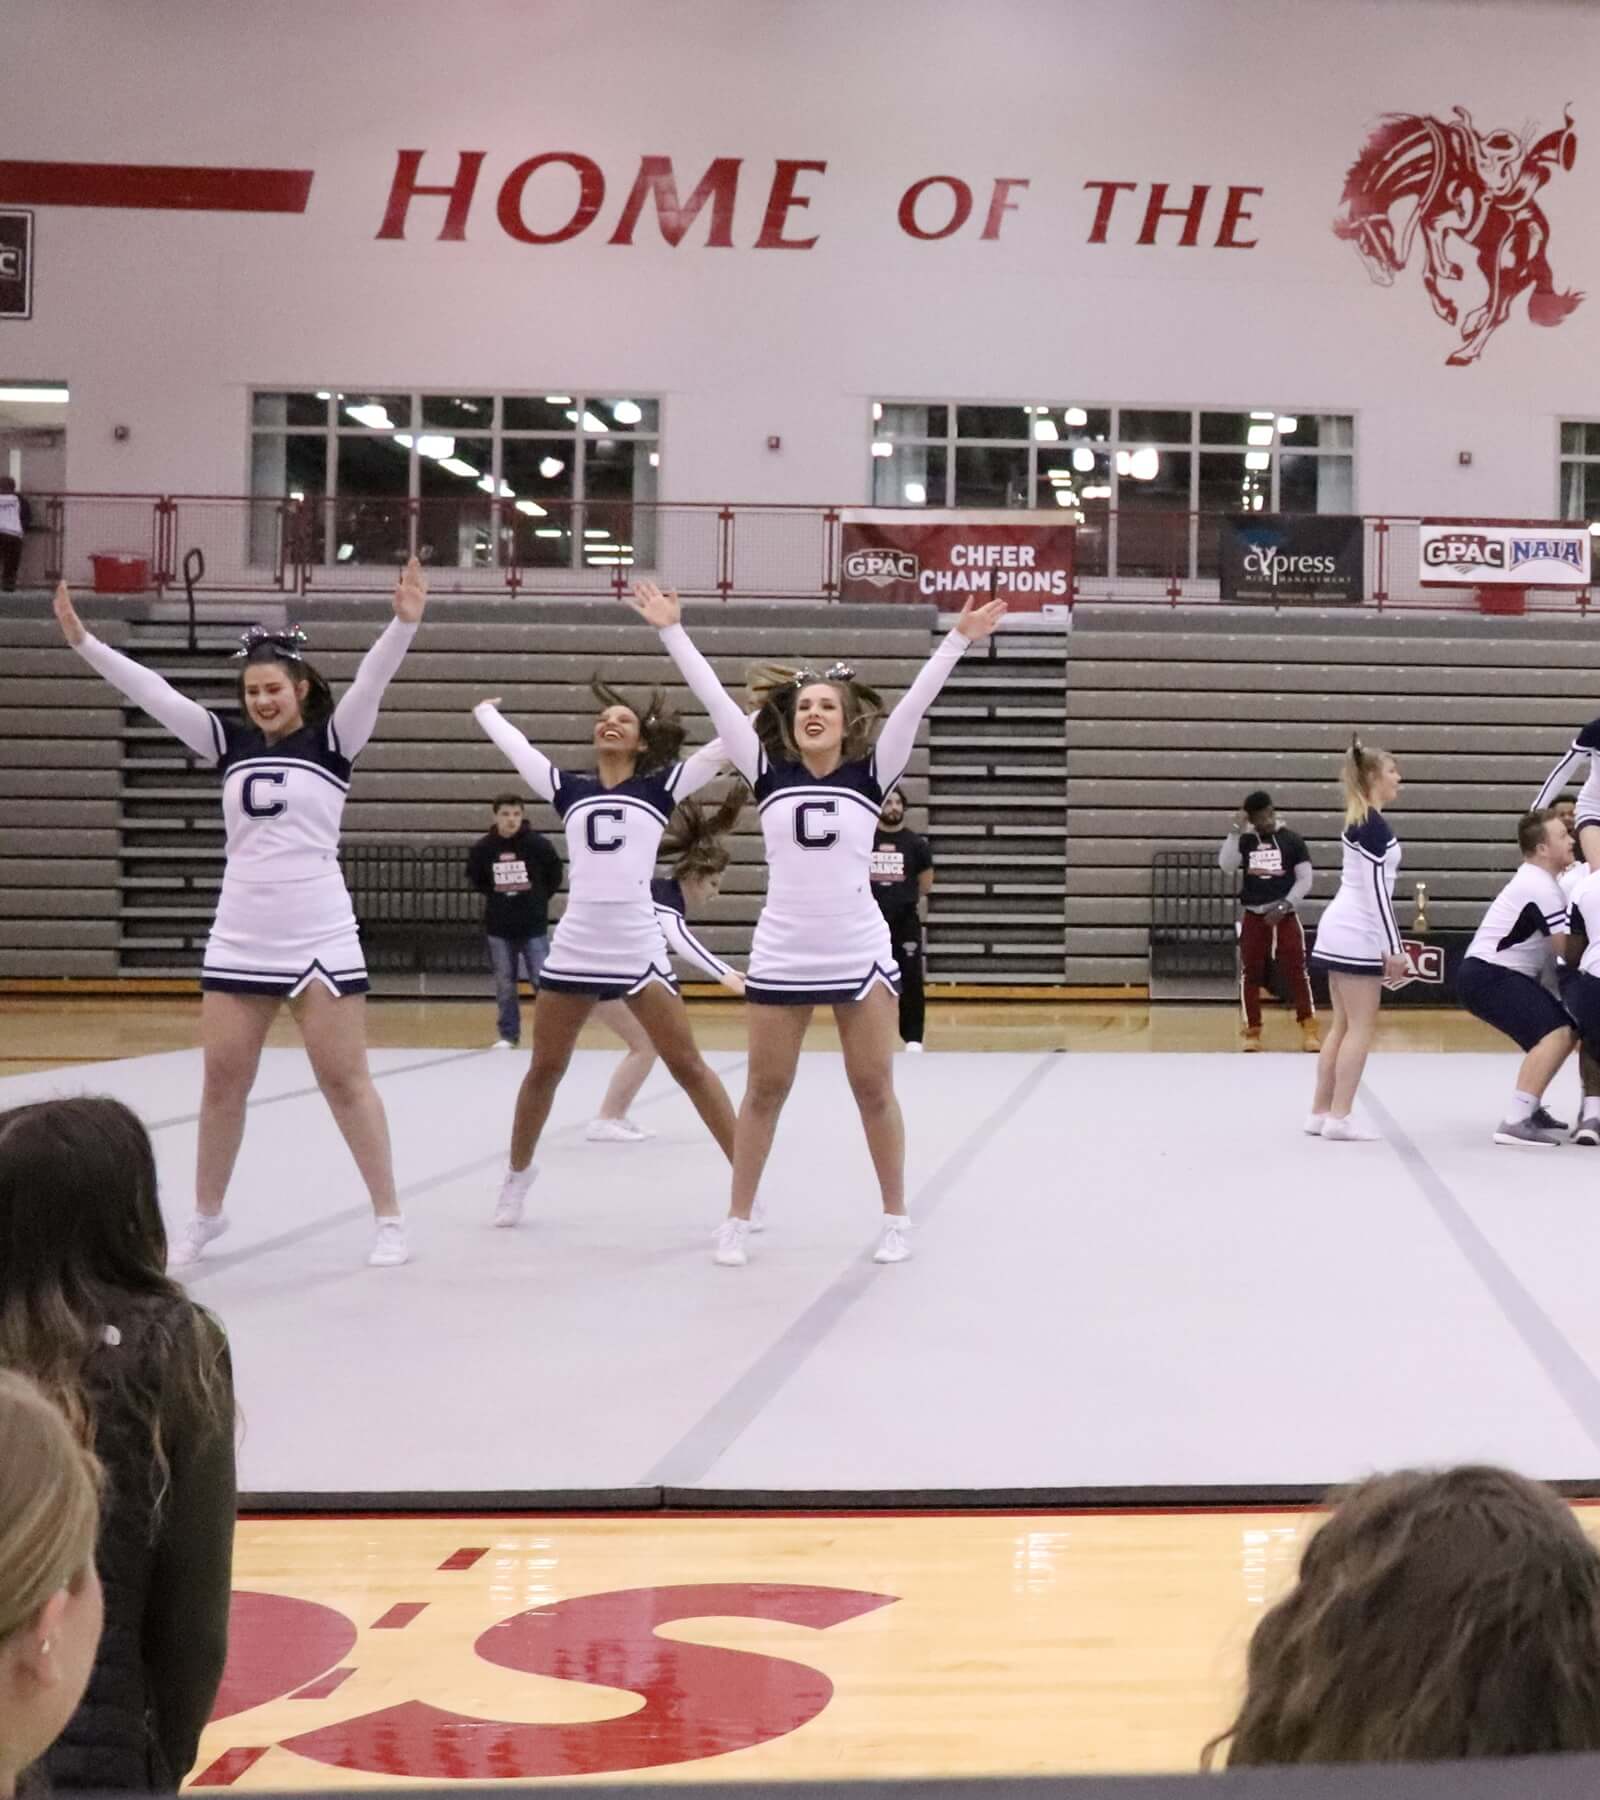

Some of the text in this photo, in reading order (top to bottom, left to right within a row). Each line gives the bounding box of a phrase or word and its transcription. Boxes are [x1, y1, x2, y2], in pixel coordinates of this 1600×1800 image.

[375, 149, 827, 249] HOME
[896, 176, 1029, 241] OF
[1083, 181, 1264, 248] THE
[848, 556, 914, 578] GPAC
[951, 545, 1035, 567] CHEER
[1425, 541, 1503, 567] GPAC
[1510, 540, 1582, 567] NAIA
[920, 570, 1067, 595] CHAMPIONS
[241, 770, 288, 819] C
[585, 807, 627, 854] C
[793, 799, 839, 850] C
